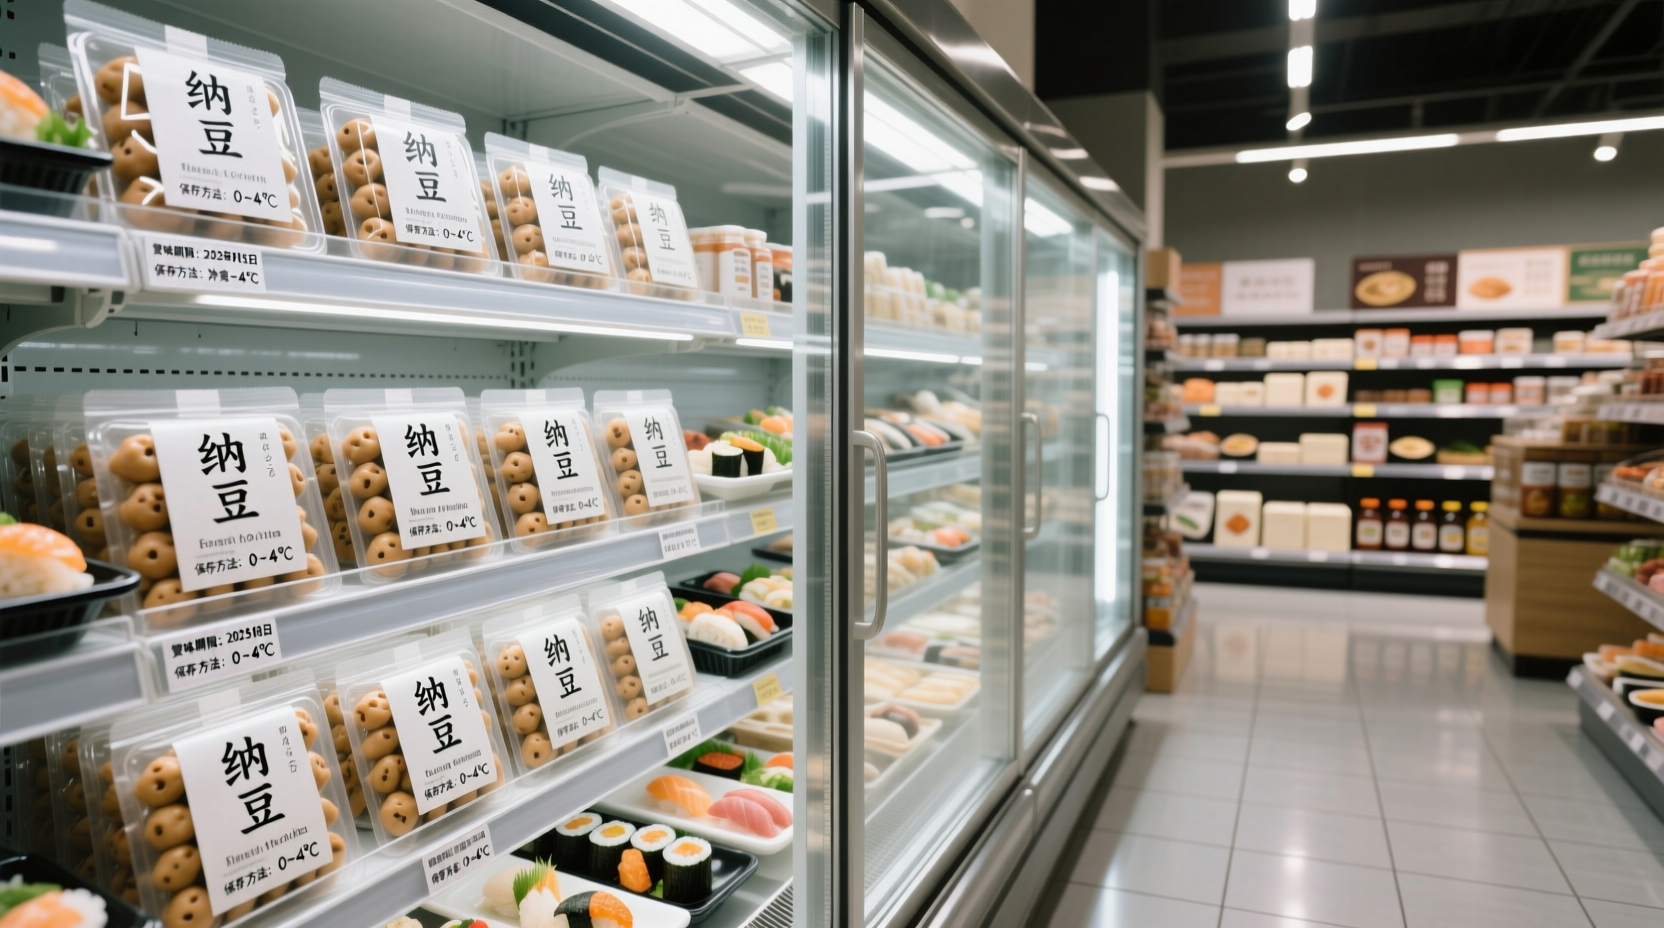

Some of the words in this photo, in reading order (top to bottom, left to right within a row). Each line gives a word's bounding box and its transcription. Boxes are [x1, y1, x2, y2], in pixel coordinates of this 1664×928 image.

[185, 69, 243, 159] 纳豆
[403, 130, 447, 203] 纳豆
[549, 173, 583, 231] 纳豆
[649, 201, 676, 251] 纳豆
[404, 422, 450, 496] 纳豆
[543, 418, 579, 480] 纳豆
[644, 416, 673, 469] 纳豆
[197, 432, 260, 524] 纳豆
[543, 633, 582, 700] 纳豆
[638, 606, 670, 662] 纳豆
[414, 676, 462, 755] 纳豆
[221, 736, 286, 835] 纳豆
